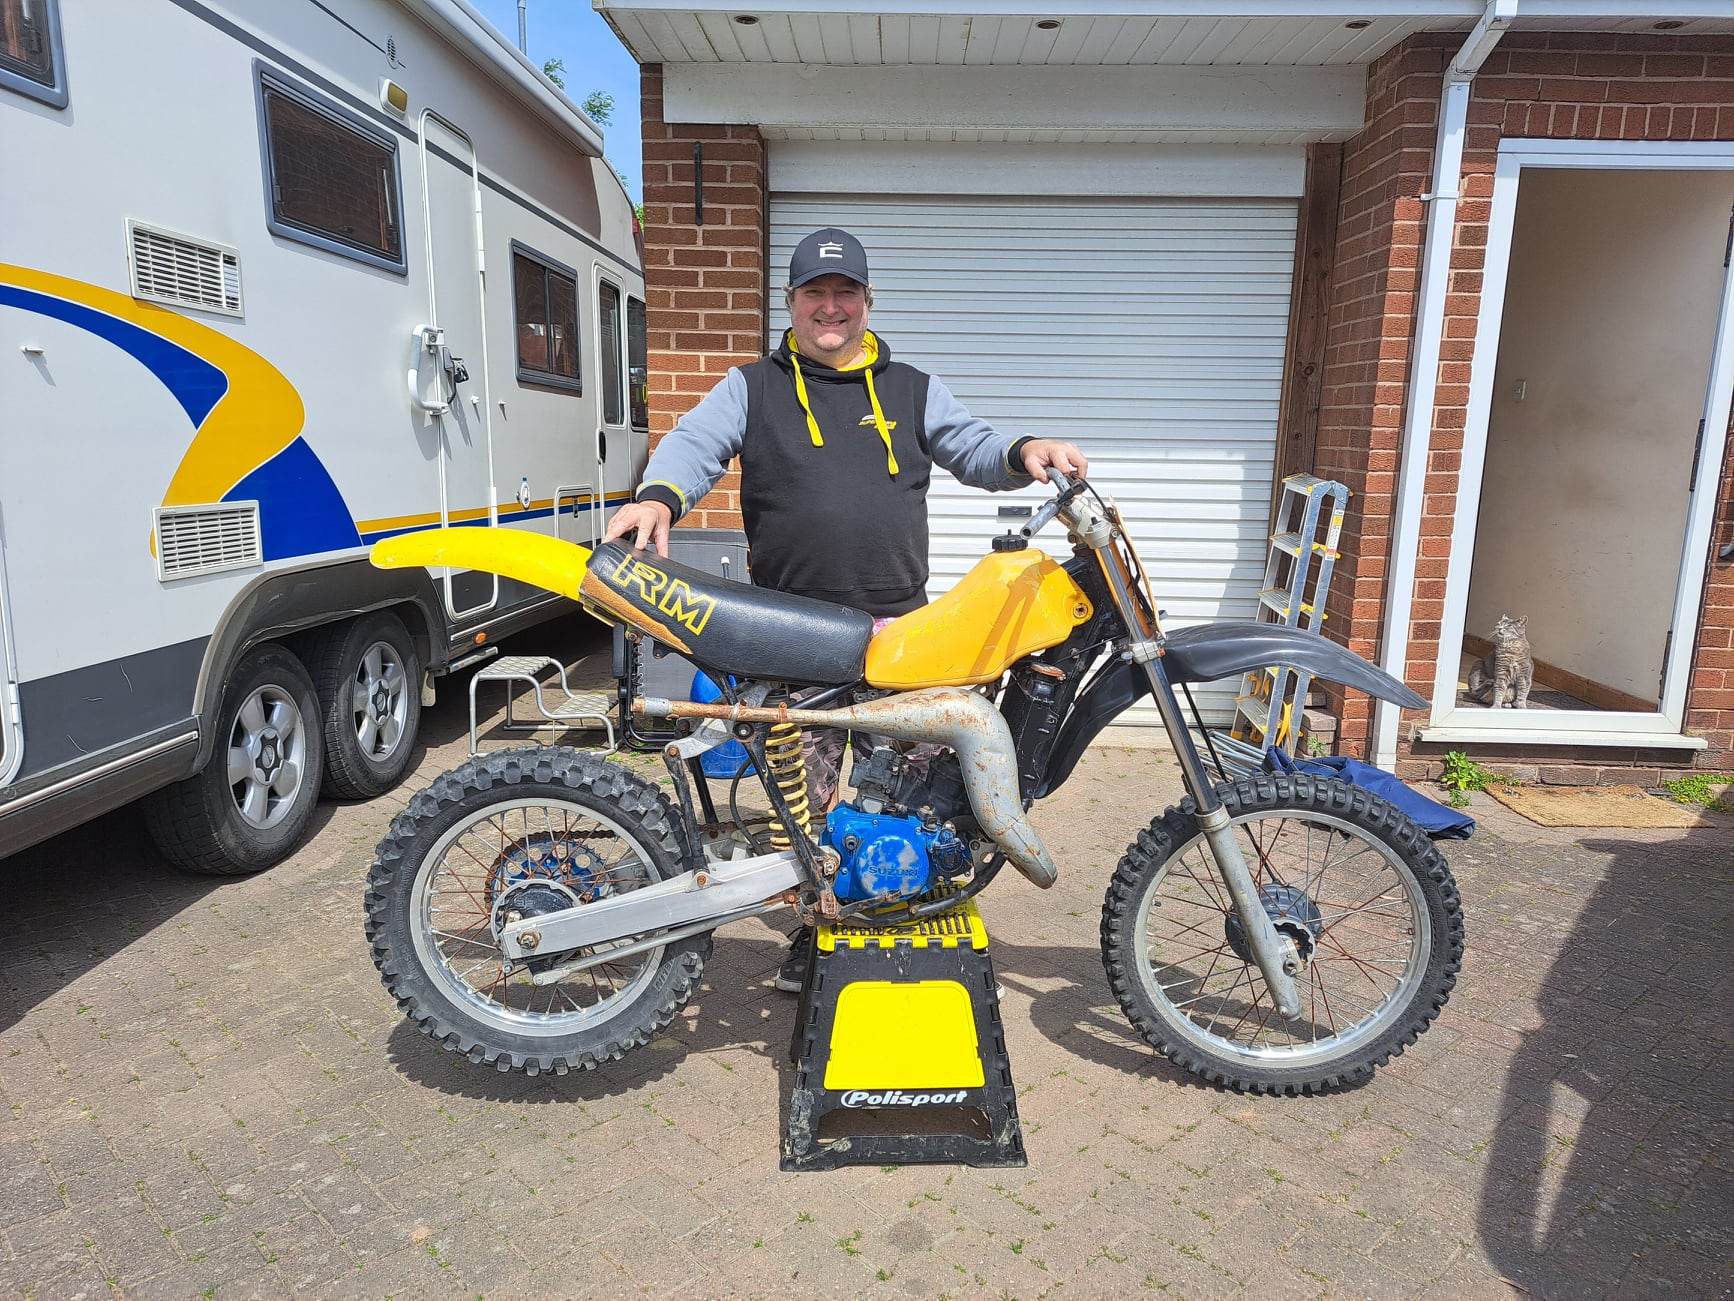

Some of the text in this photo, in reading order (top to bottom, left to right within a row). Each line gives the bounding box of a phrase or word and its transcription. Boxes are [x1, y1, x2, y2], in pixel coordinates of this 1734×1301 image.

[612, 553, 718, 636] RM
[868, 865, 921, 877] SUZUKI
[841, 1090, 968, 1108] Polisport
